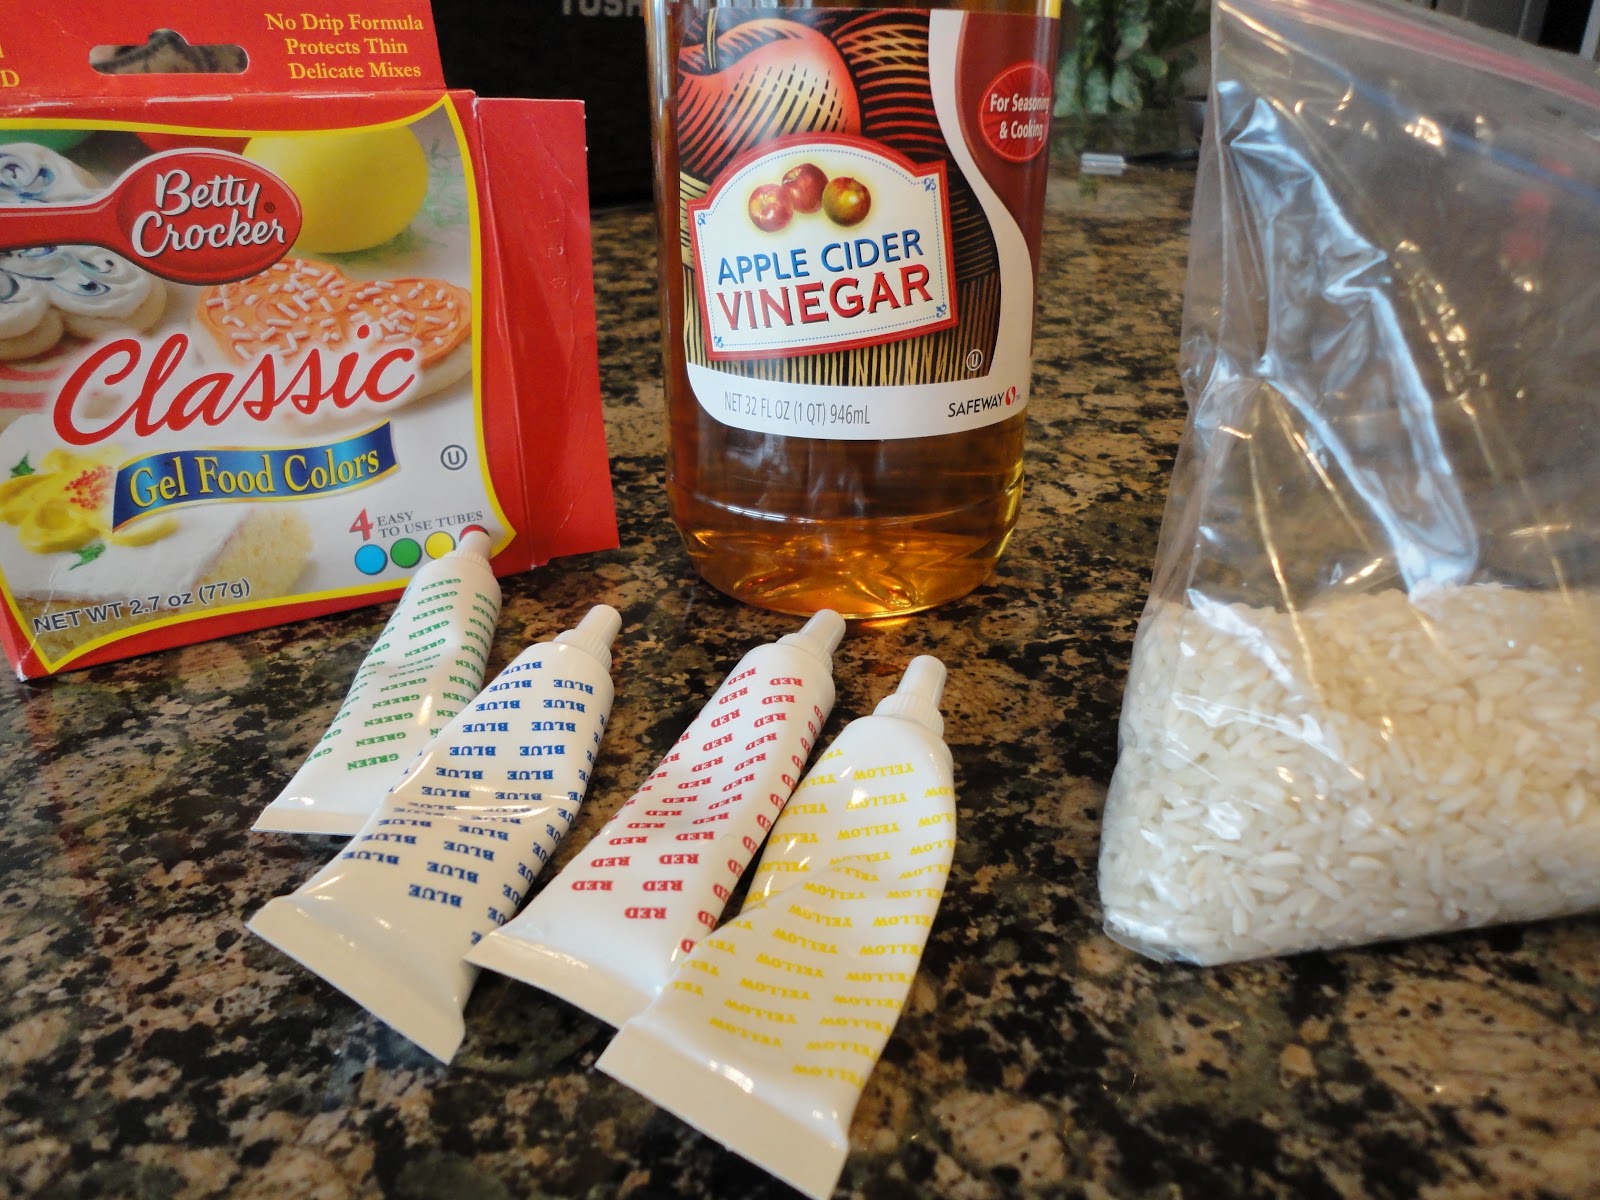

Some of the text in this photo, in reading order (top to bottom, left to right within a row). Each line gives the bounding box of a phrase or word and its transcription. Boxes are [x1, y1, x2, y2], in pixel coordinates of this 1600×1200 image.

[265, 13, 424, 36] No Drip Formula
[286, 38, 408, 55] Protects Thin
[290, 62, 421, 80] Delicate Mixes
[990, 93, 1050, 114] For Seasoning
[1000, 119, 1043, 141] & Cooking
[155, 169, 262, 218] Betty
[131, 210, 286, 259] Crocker
[717, 228, 925, 286] APPLE CIDER
[715, 263, 934, 331] VINEGAR
[53, 324, 416, 446] Classic
[724, 391, 870, 425] NET 32 FL OZ (1 QT) 946mL
[947, 392, 1004, 418] SAFEWAY
[129, 447, 381, 509] Gel Food Colors
[349, 508, 374, 541] 4
[377, 511, 414, 527] EASY
[378, 510, 484, 539] TO USE TUBES
[421, 578, 461, 591] GREEN
[417, 591, 458, 605] GREEN
[32, 578, 251, 636] NET WT 2.7 oz (77g)
[412, 604, 453, 621] GREEN
[408, 620, 449, 640] GREEN
[404, 637, 446, 656] GREEN
[456, 660, 484, 680] REEN
[503, 661, 542, 675] BLUE
[728, 668, 756, 685] RED
[380, 678, 427, 691] GREEN
[449, 676, 478, 691] REEN
[489, 679, 531, 692] BLUE
[553, 678, 593, 695] BLUE
[770, 678, 803, 686] RED
[372, 694, 421, 708] GREEN
[442, 692, 470, 704] EEN
[719, 687, 748, 704] RED
[762, 695, 795, 705] RED
[476, 700, 520, 711] BLUE
[544, 699, 585, 712] BLUE
[364, 712, 414, 727] GREEN
[532, 721, 575, 732] BLUE
[711, 709, 740, 728] RED
[754, 712, 787, 728] RED
[464, 722, 508, 733] BLUE
[356, 730, 407, 747] GREEN
[703, 733, 733, 751] RED
[745, 733, 777, 750] RED
[451, 746, 496, 756] BLUE
[521, 745, 564, 756] BLUE
[346, 752, 400, 772] GREEN
[691, 757, 723, 772] RED
[735, 753, 766, 771] RED
[436, 768, 483, 780] BLUE
[508, 769, 553, 780] BLUE
[853, 763, 914, 781] YELLOW
[677, 777, 711, 789] RED
[722, 774, 755, 792] RED
[781, 774, 796, 793] ED
[800, 774, 836, 788] YELL
[422, 786, 470, 798] BLUE
[496, 792, 542, 801] BLUE
[568, 792, 583, 802] UE
[662, 795, 698, 804] RED
[708, 794, 742, 810] RED
[769, 794, 785, 812] ED
[558, 808, 575, 824] UE
[693, 812, 729, 825] RED
[780, 804, 827, 818] YELLO
[378, 819, 431, 827] BLUE
[756, 814, 773, 832] ED
[837, 822, 899, 841] YELLOW
[361, 833, 416, 844] BLUE
[460, 825, 509, 841] BLUE
[546, 824, 562, 844] UE
[609, 836, 648, 845] RED
[676, 831, 714, 841] RED
[768, 833, 818, 846] YELLO
[444, 841, 494, 862] BLUE
[532, 842, 549, 863] UE
[742, 836, 757, 854] ED
[910, 839, 957, 855] LLOW
[342, 847, 399, 865] BLUE
[591, 856, 630, 867] RED
[659, 854, 698, 864] RED
[427, 861, 478, 884] BLUE
[518, 862, 536, 885] UE
[728, 859, 743, 876] ED
[757, 861, 809, 874] YELLO
[900, 864, 952, 880] ELLOW
[572, 880, 612, 891] RED
[643, 880, 682, 891] RED
[713, 884, 730, 901] ED
[803, 882, 864, 900] YELLOW
[409, 884, 462, 908] BLUE
[504, 886, 522, 905] UE
[887, 888, 942, 901] ELLOW
[489, 908, 506, 926] UE
[625, 907, 666, 919] RED
[697, 910, 717, 930] ED
[788, 904, 852, 928] YELLOW
[873, 915, 933, 928] ELLOW
[772, 928, 838, 954] YELLOW
[859, 944, 924, 957] ELLOW
[756, 953, 824, 978] YELLOW
[739, 978, 810, 1000] YELLOW
[724, 999, 796, 1024] YELLOW
[709, 1017, 781, 1047] YELLOW
